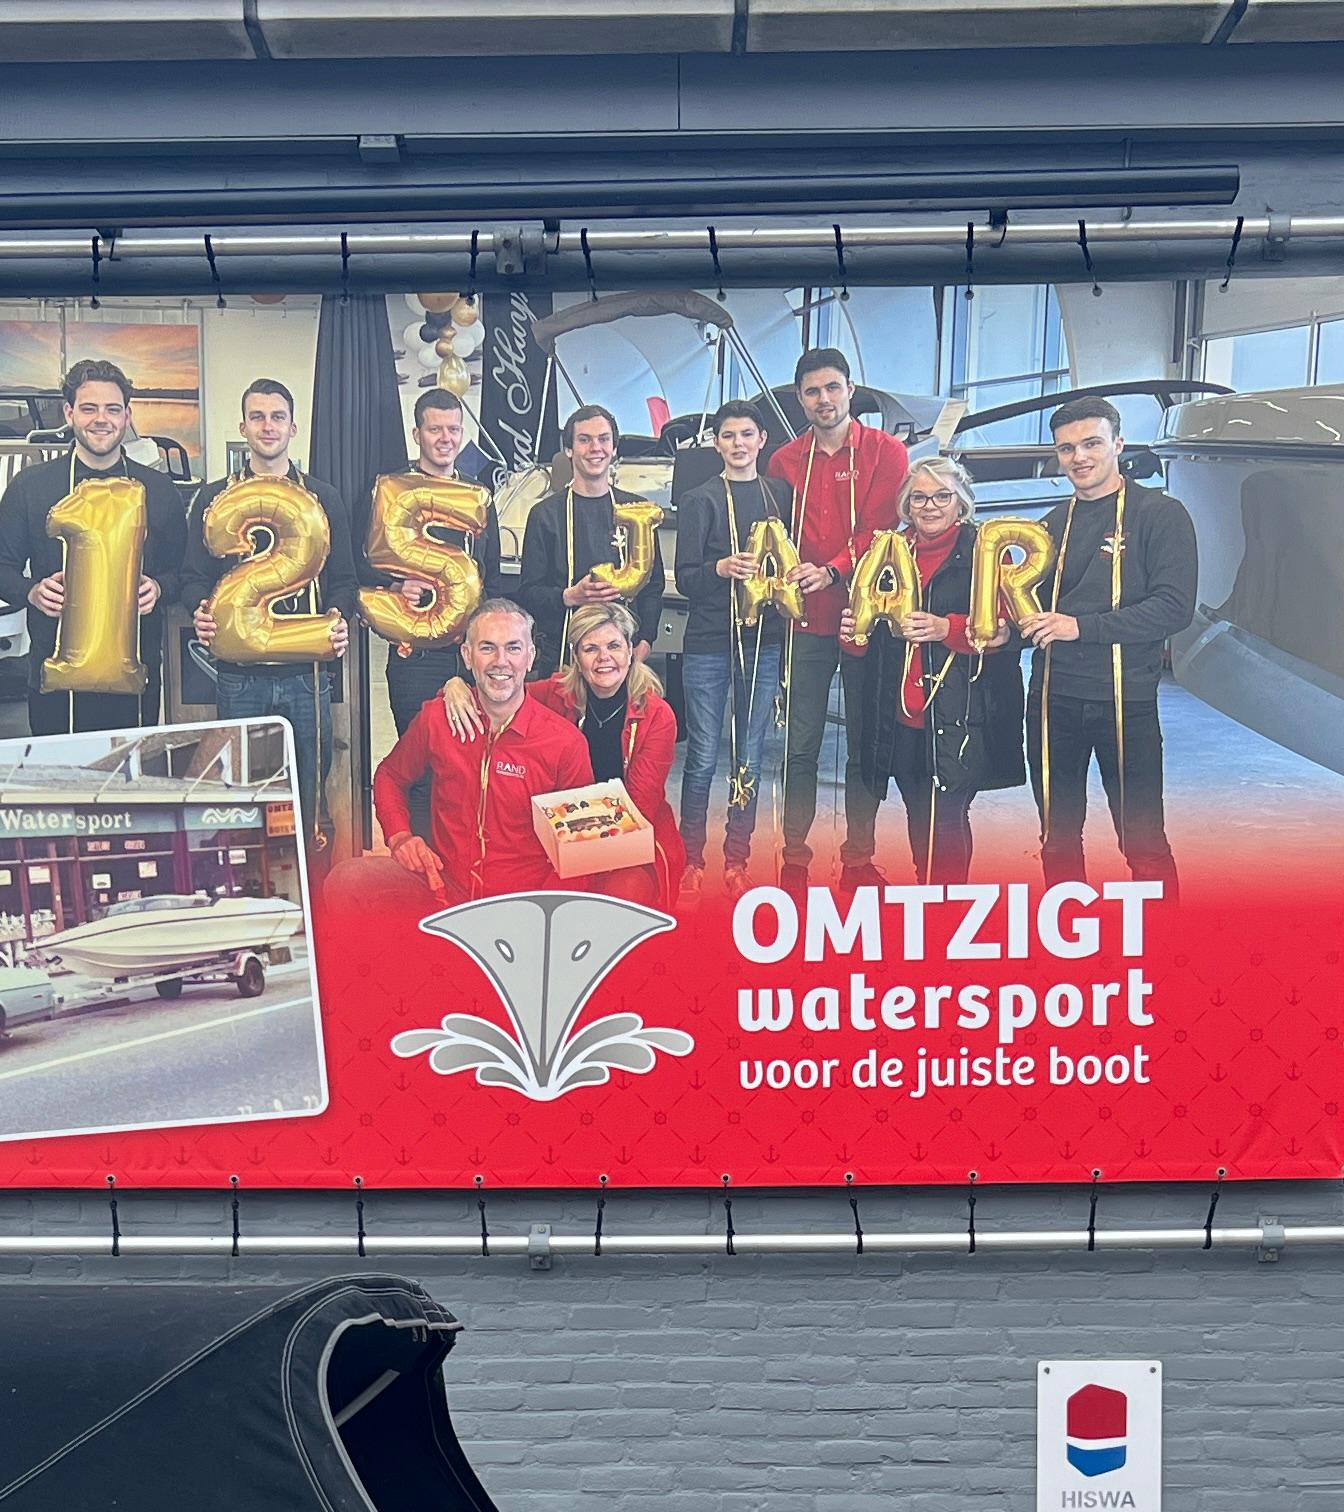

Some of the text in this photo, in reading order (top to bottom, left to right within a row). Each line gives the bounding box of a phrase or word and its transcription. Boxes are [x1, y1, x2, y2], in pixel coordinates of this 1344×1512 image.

[40, 473, 1055, 696] 125 JAAR
[496, 761, 527, 775] RAND
[732, 880, 1164, 964] OMTZIGT
[737, 968, 1155, 1044] watersport
[739, 1045, 1151, 1098] voor de juiste boot
[1061, 1490, 1136, 1509] HISWA
